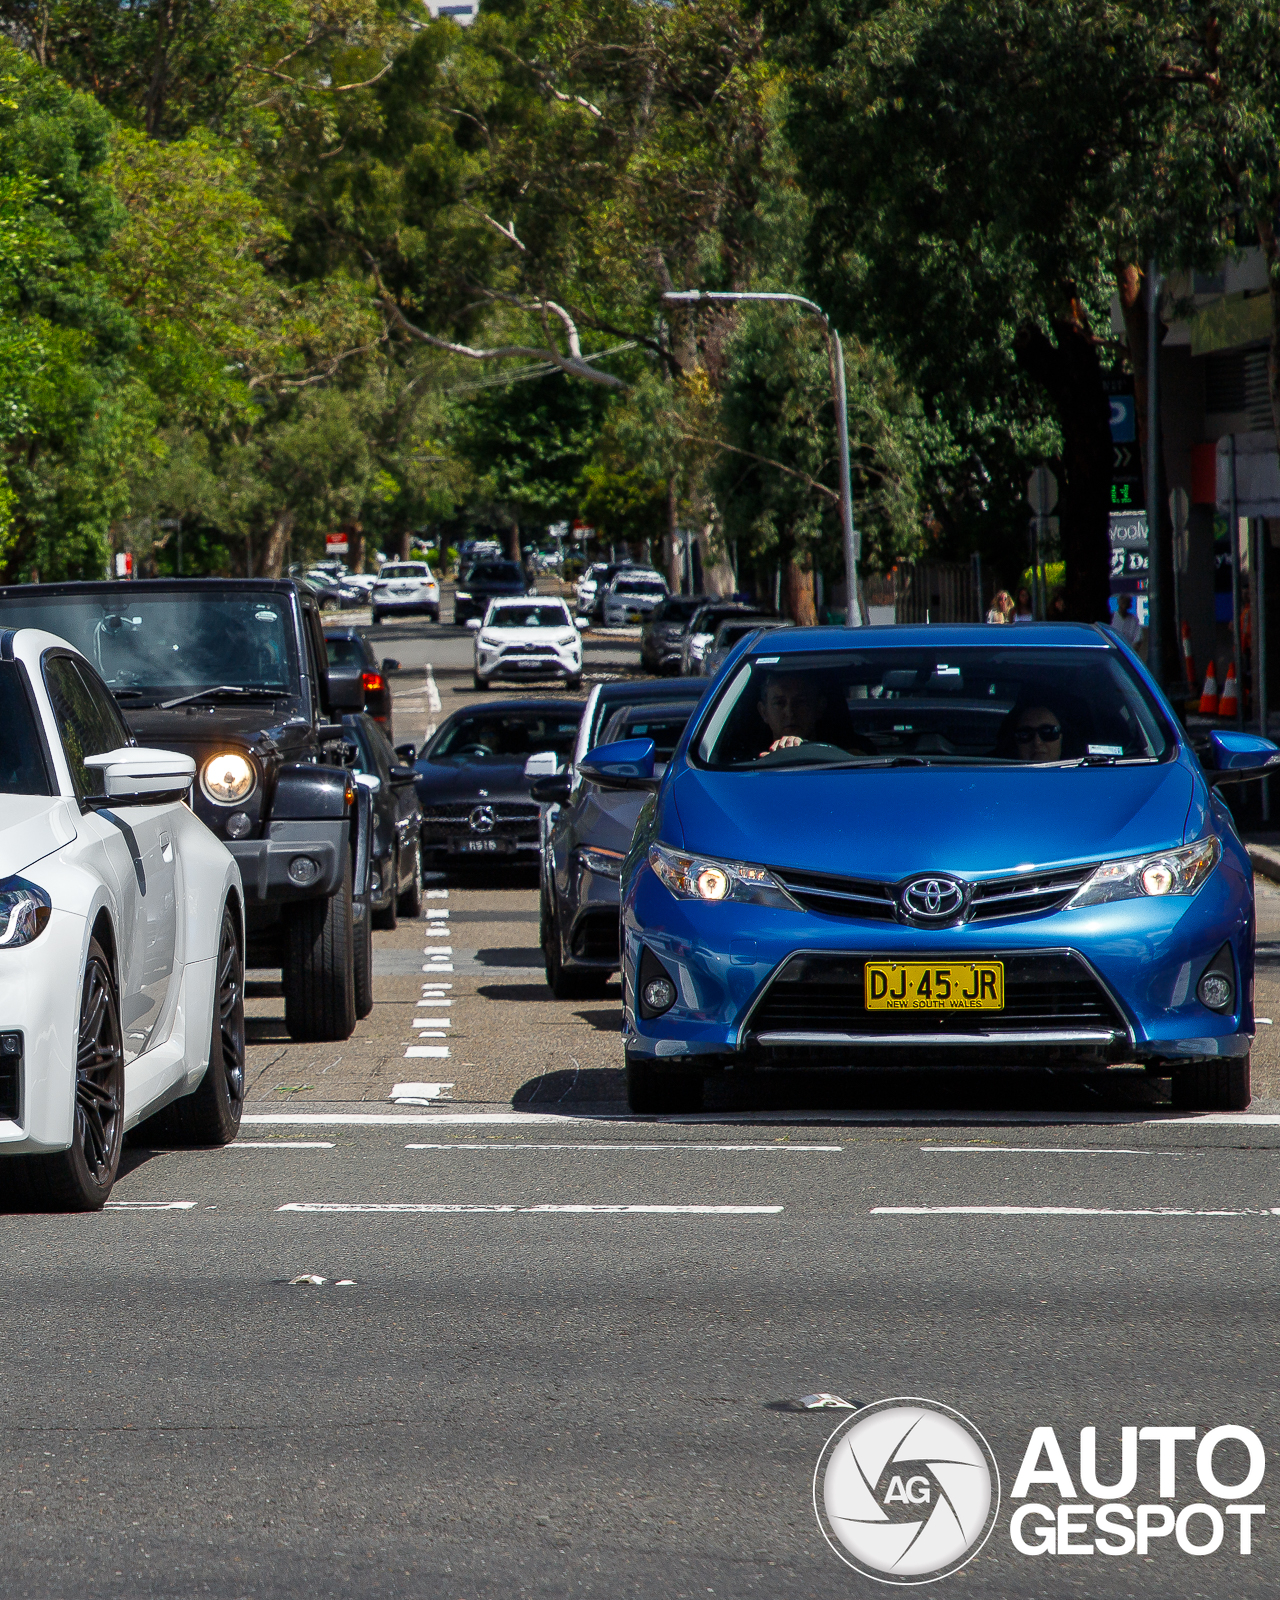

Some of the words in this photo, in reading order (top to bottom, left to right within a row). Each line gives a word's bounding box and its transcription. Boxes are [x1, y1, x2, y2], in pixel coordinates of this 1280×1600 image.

[886, 1000, 909, 1008] NEW
[912, 1000, 945, 1008] SOUTH
[949, 1000, 982, 1008] WALES
